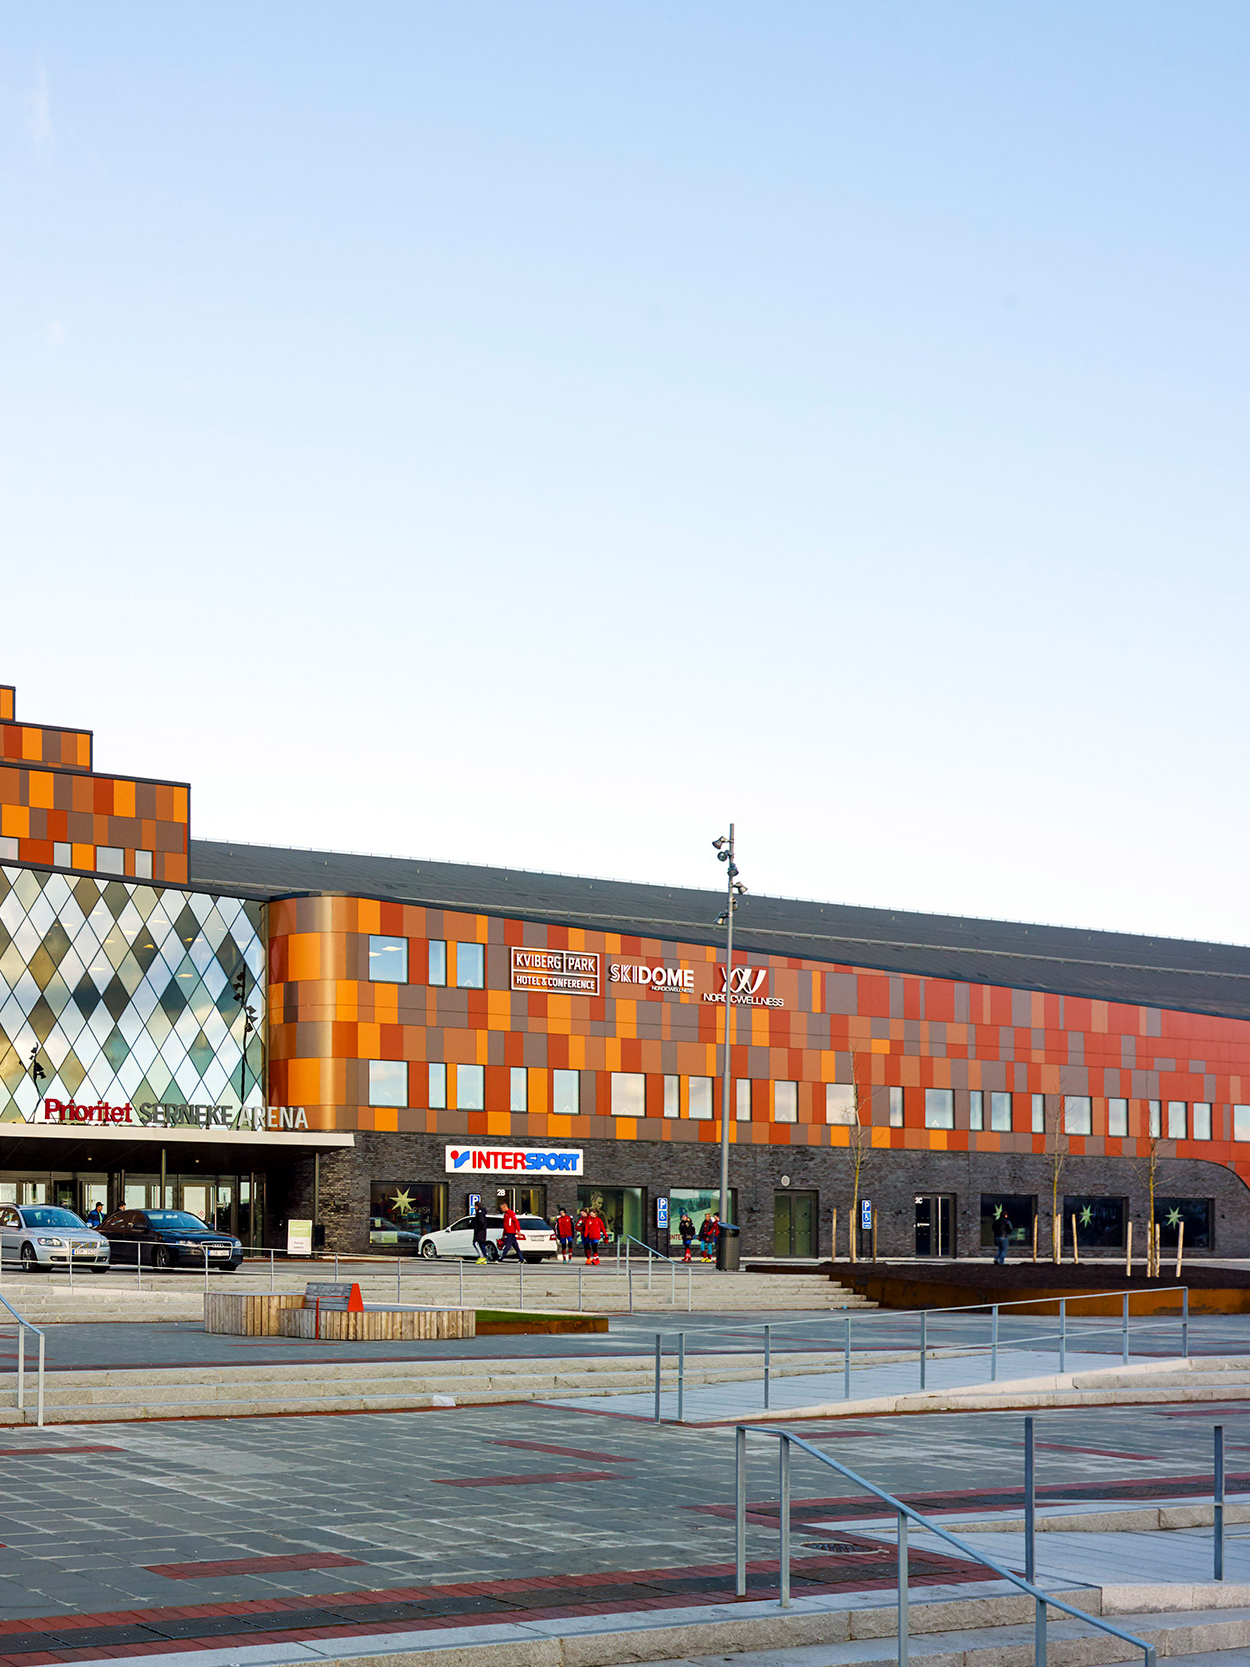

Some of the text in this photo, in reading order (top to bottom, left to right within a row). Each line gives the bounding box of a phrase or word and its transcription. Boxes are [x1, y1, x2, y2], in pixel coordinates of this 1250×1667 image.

[516, 953, 596, 972] KVIBERG PARK
[516, 975, 540, 987] HOTEL
[548, 977, 595, 990] CONFERENCE
[703, 992, 785, 1007] NORDCWELLNESS
[45, 1098, 309, 1129] Prioritet SERNEKE ARENA
[472, 1150, 580, 1171] INTERSPORT
[660, 1199, 666, 1209] P
[864, 1201, 870, 1211] P
